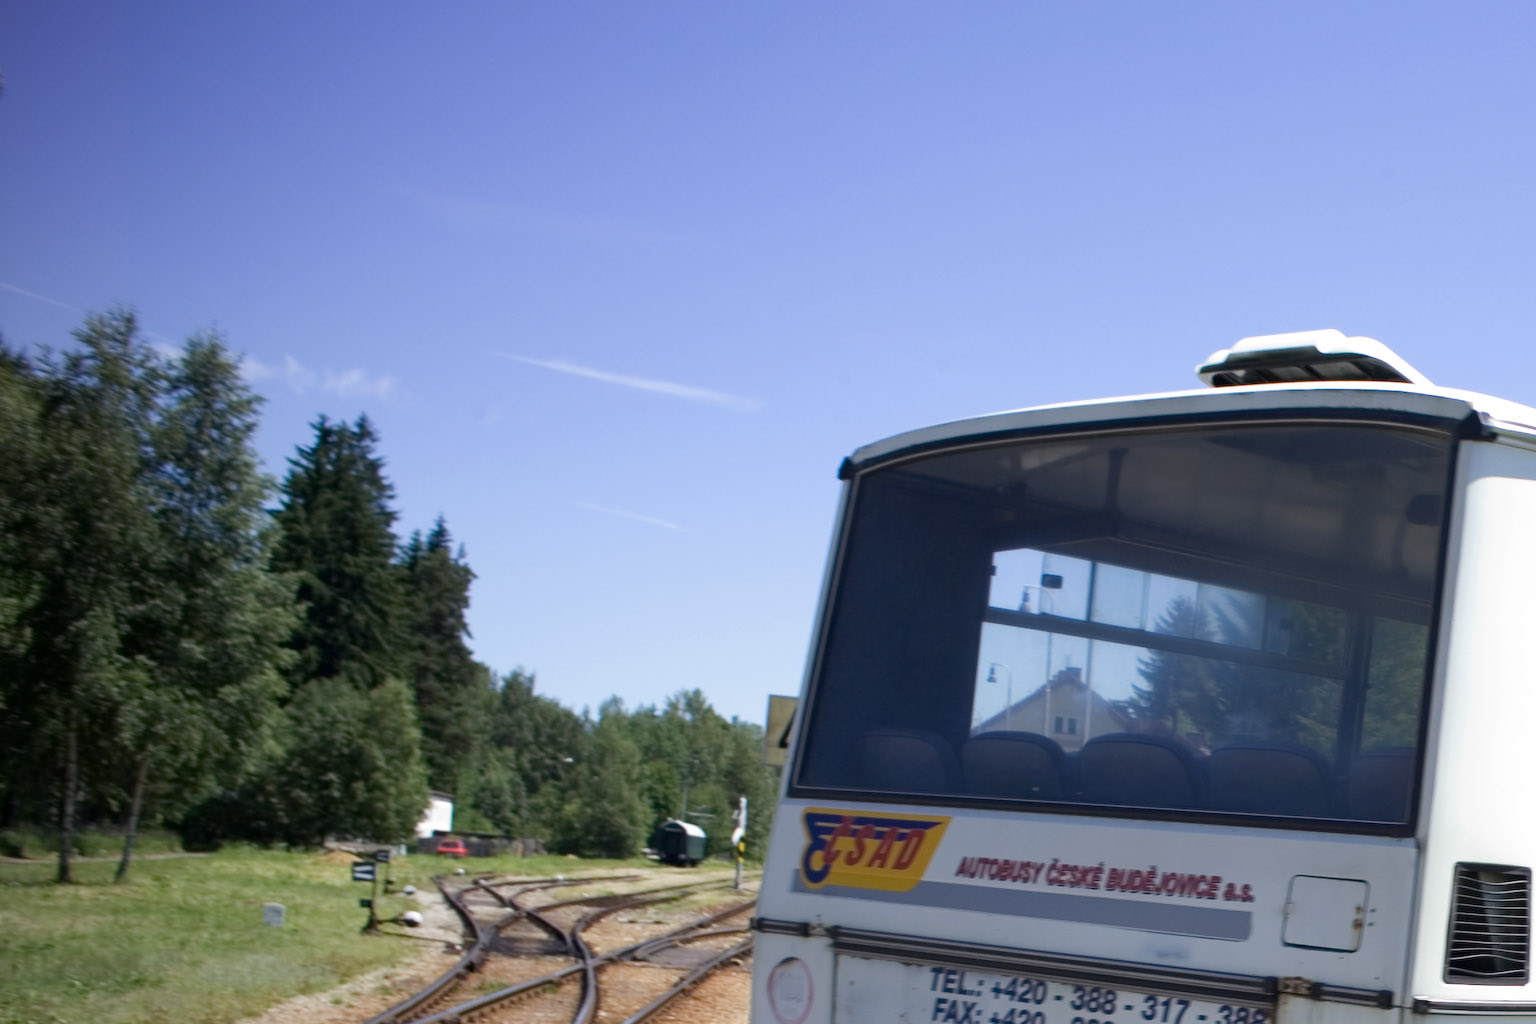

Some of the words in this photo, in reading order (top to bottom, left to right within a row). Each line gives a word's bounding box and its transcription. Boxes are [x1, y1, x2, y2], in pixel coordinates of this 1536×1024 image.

[823, 815, 927, 870] ČSAD
[955, 856, 1045, 884] AUTOBUSY
[1047, 858, 1104, 889] ČESKÉ
[1105, 865, 1222, 900] BUDĚJOVICE
[1224, 882, 1255, 902] a.s.
[930, 967, 984, 997] TEL.:
[990, 977, 1048, 1005] +420
[1071, 985, 1117, 1015] 388
[1141, 995, 1191, 1024] 317
